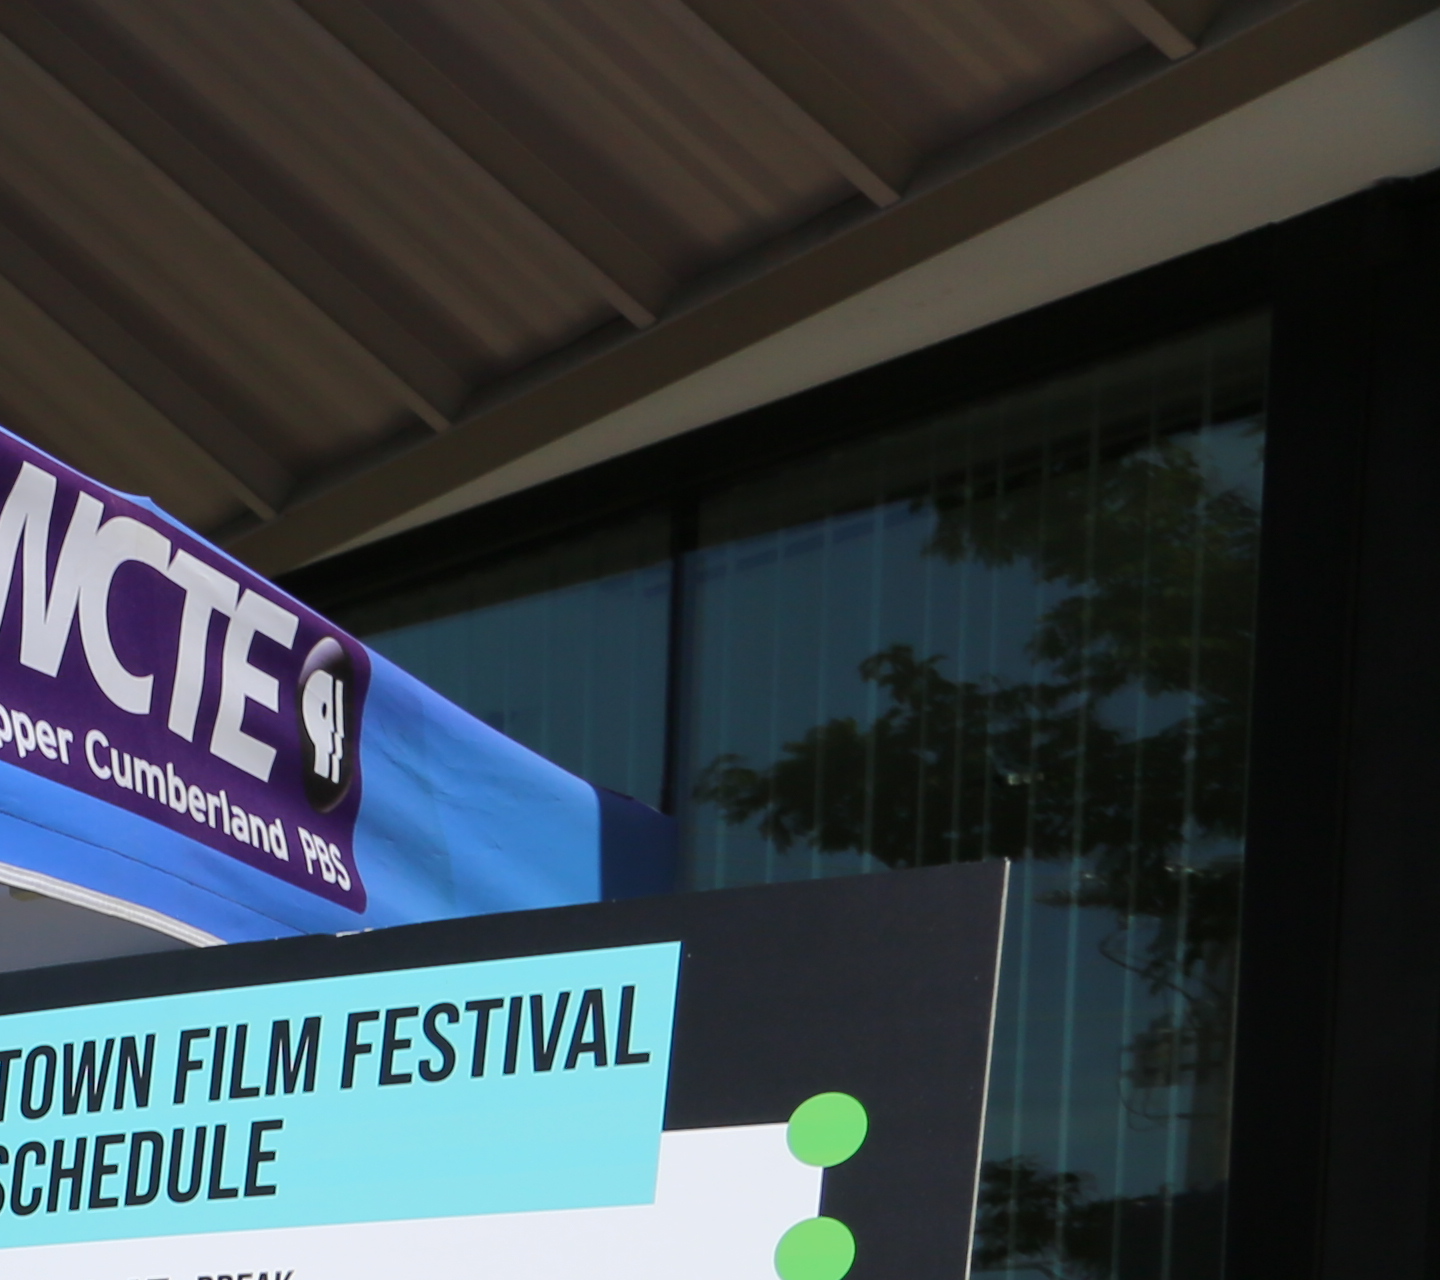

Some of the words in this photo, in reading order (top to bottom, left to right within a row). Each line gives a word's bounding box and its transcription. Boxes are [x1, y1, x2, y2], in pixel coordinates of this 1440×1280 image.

[84, 728, 289, 862] Cumberland
[297, 825, 352, 893] PBS
[171, 1014, 323, 1106] FILM
[339, 983, 651, 1091] FESTIVAL
